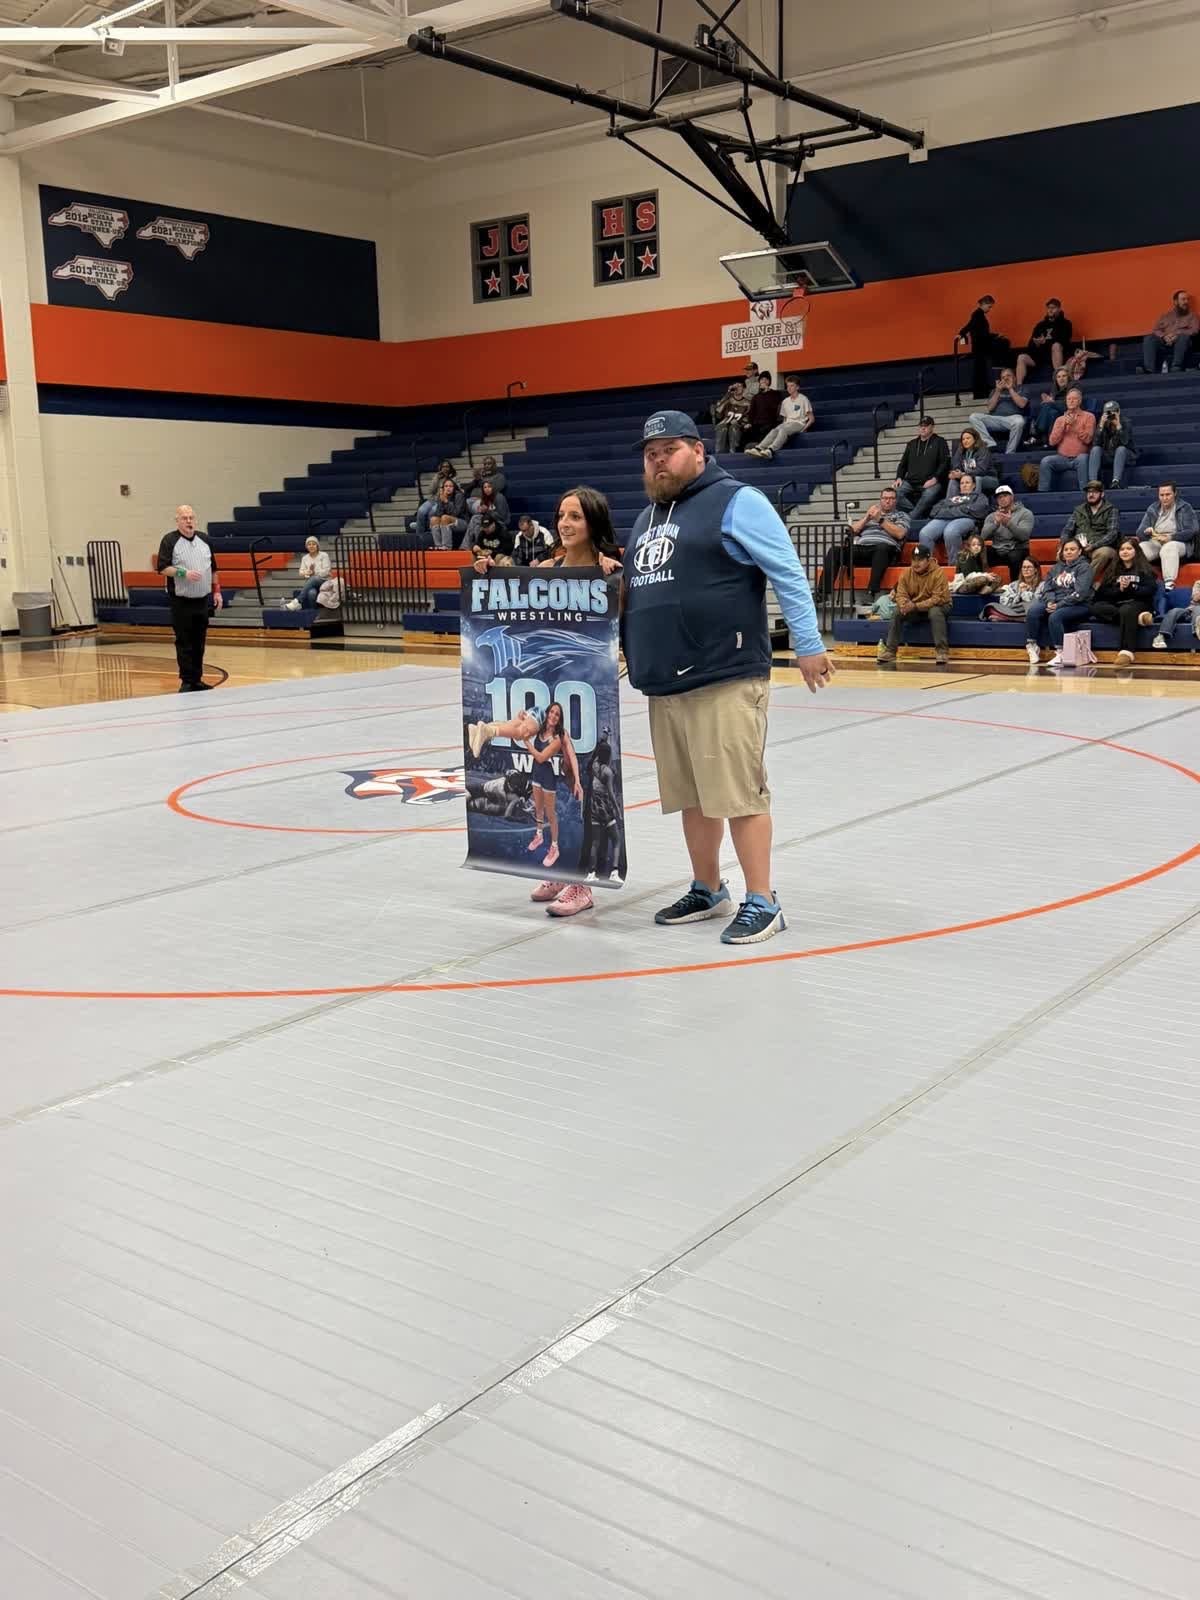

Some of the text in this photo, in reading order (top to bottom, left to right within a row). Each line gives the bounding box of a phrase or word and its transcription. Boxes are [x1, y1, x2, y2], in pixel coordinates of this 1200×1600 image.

[65, 211, 88, 223] 2012
[91, 219, 112, 228] STATE
[602, 201, 656, 237] H S
[151, 225, 172, 236] 2021
[175, 232, 195, 240] STATE
[482, 223, 528, 257] J C
[69, 264, 92, 275] 2013
[95, 271, 117, 280] STATE
[731, 321, 798, 341] ORANGE &
[726, 333, 801, 354] BLUE CREW
[630, 569, 675, 588] FOOTBALL
[471, 578, 608, 614] FALCONS
[497, 611, 583, 622] WRESTLING
[485, 677, 597, 753] 100
